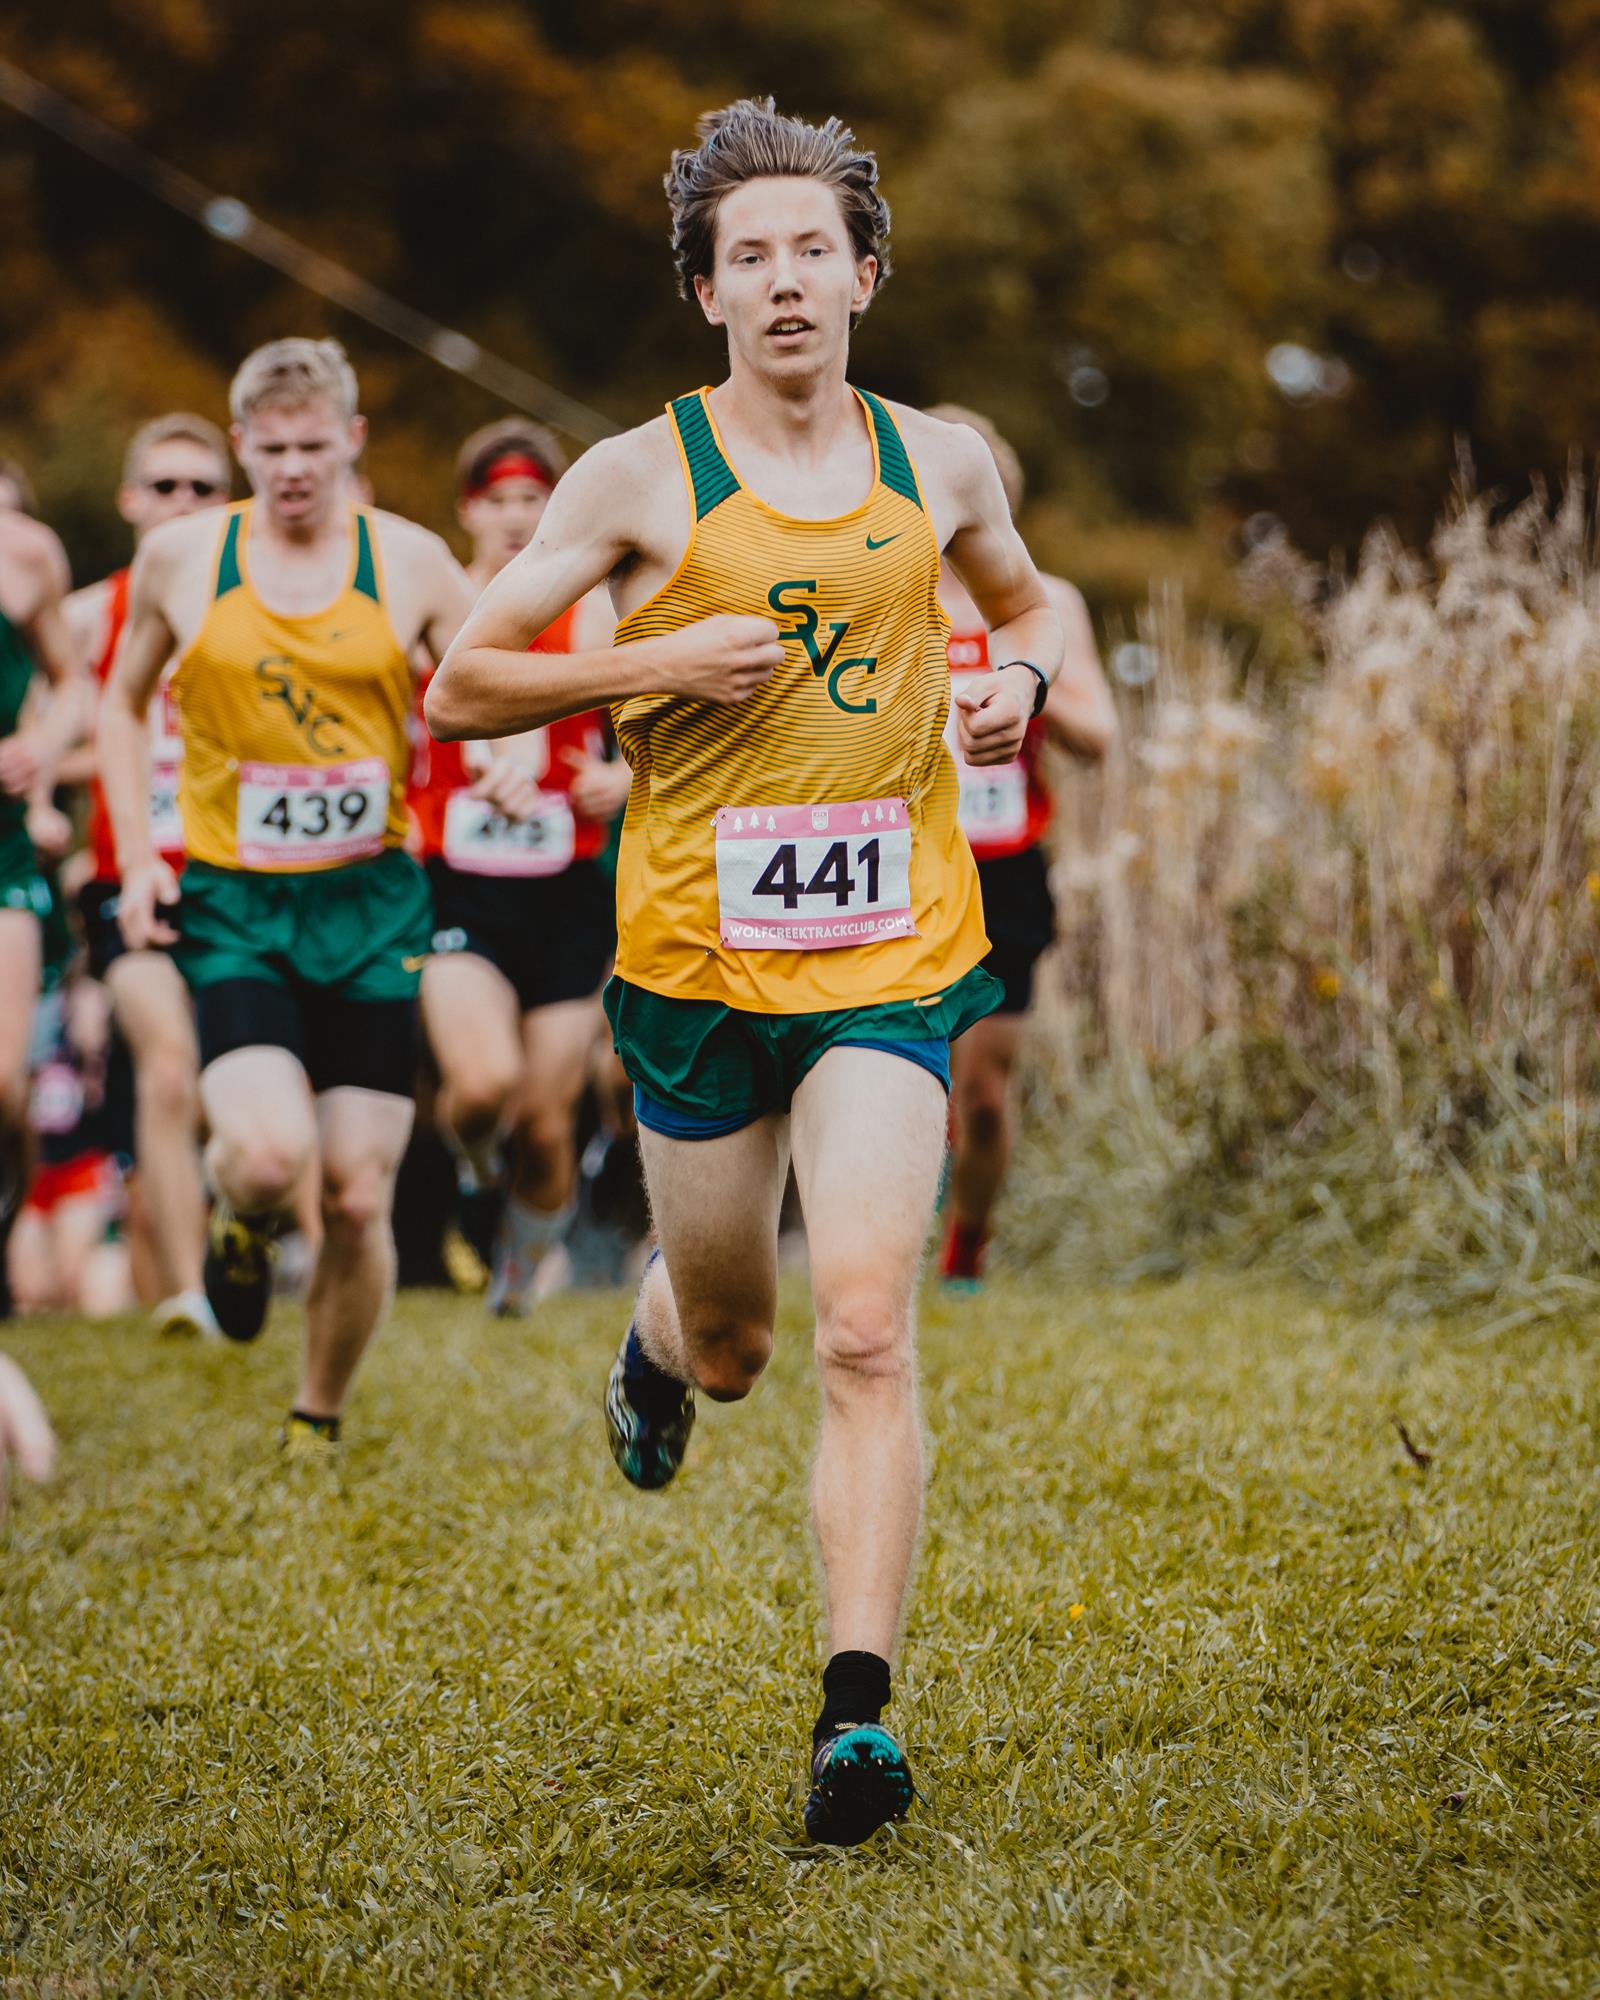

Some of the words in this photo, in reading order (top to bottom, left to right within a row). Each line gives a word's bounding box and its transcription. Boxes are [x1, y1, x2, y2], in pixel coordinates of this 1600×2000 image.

[767, 579, 878, 714] SVC
[256, 656, 343, 756] SVC
[262, 791, 367, 835] 439
[752, 838, 880, 909] 441
[729, 917, 907, 939] WOLFCREEKTRACKCLUB.COM
